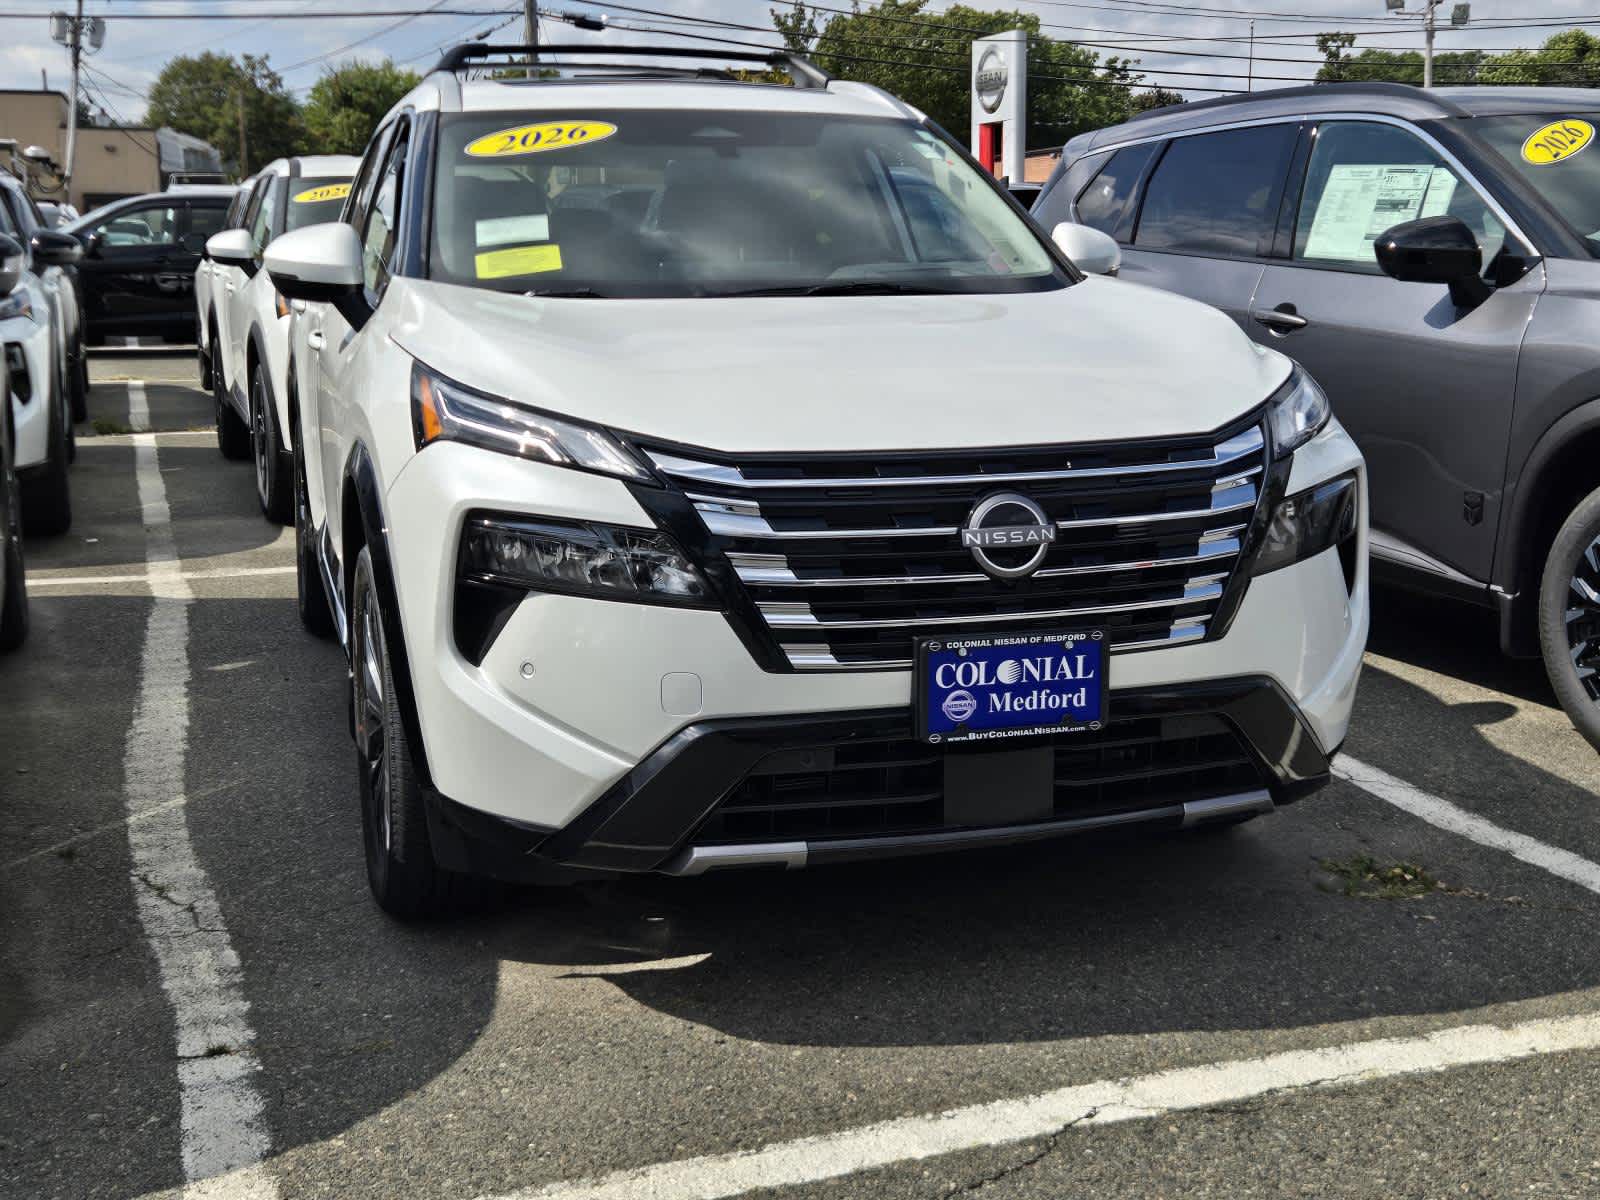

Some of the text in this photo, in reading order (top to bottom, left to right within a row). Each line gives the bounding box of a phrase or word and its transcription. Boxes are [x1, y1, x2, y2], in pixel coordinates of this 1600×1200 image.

[496, 126, 588, 153] 2026
[1534, 123, 1585, 159] 2026
[965, 527, 1054, 545] NISSAN
[946, 633, 1087, 649] COLONIAL NISSAN OF MEDFORD
[935, 654, 1095, 689] COLONIAL
[989, 687, 1087, 713] Medford
